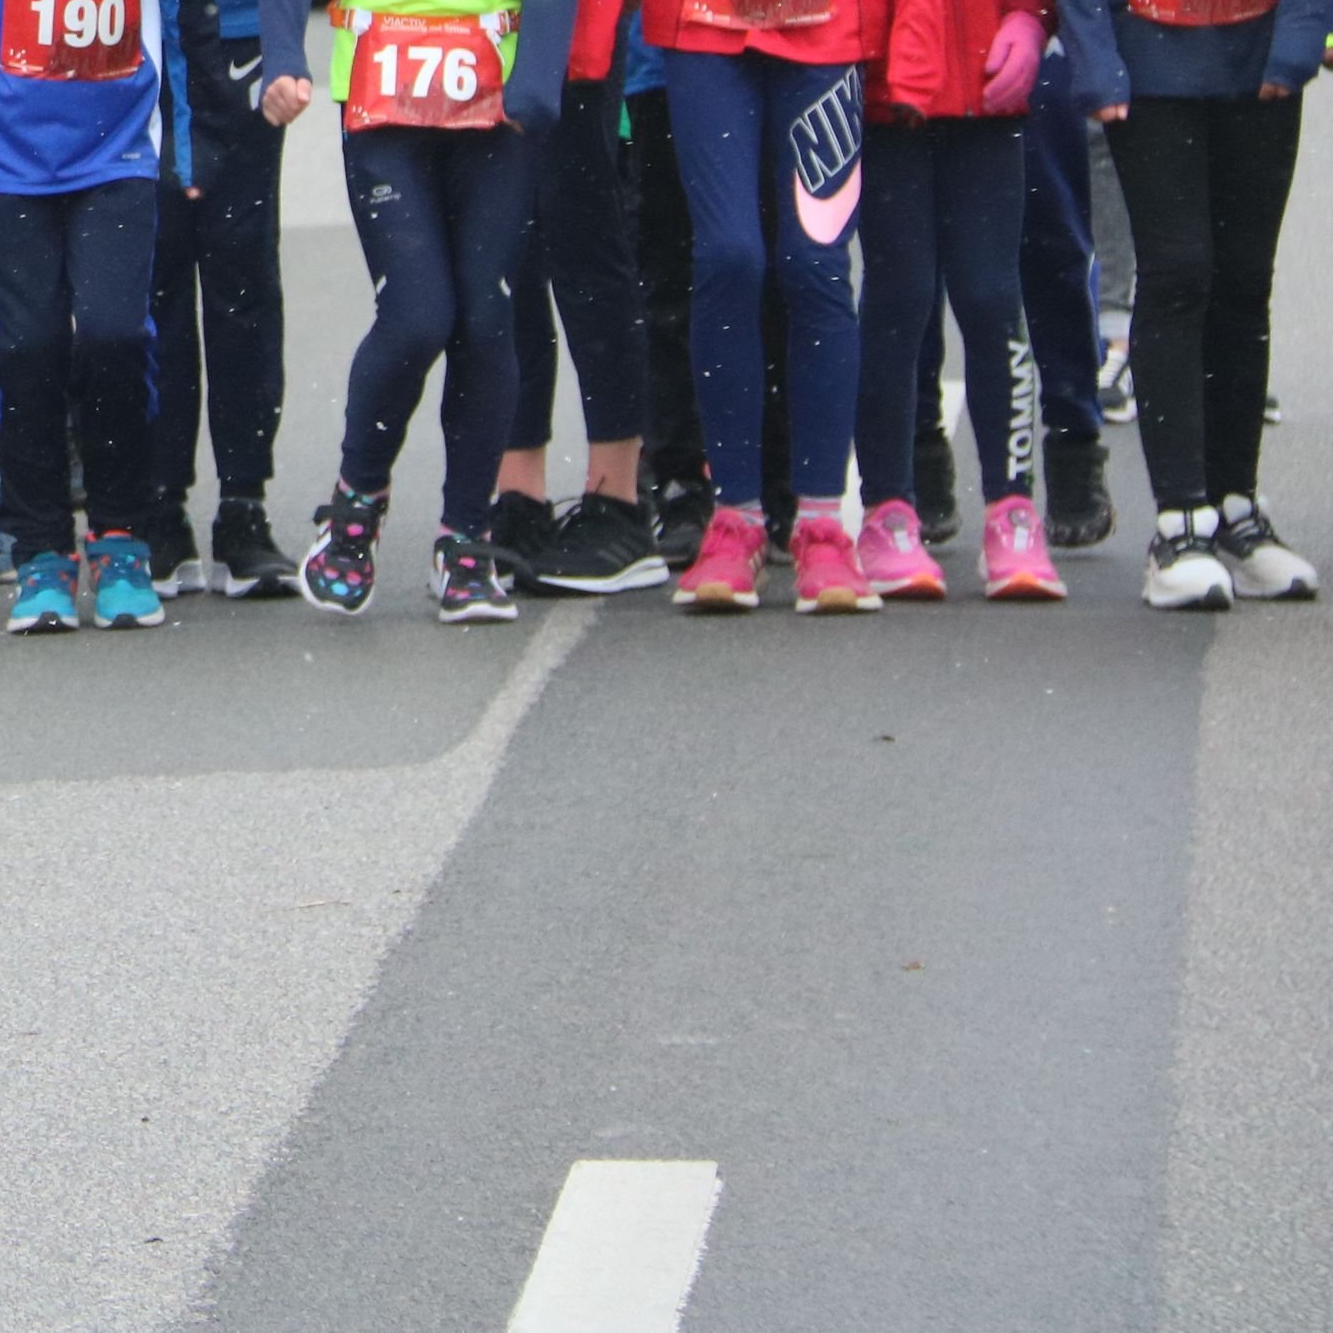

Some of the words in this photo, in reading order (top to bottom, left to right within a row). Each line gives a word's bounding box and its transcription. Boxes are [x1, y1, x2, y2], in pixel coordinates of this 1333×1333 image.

[383, 16, 427, 27] VIACTIV
[373, 44, 478, 102] 176
[1007, 340, 1033, 481] TOMMY
